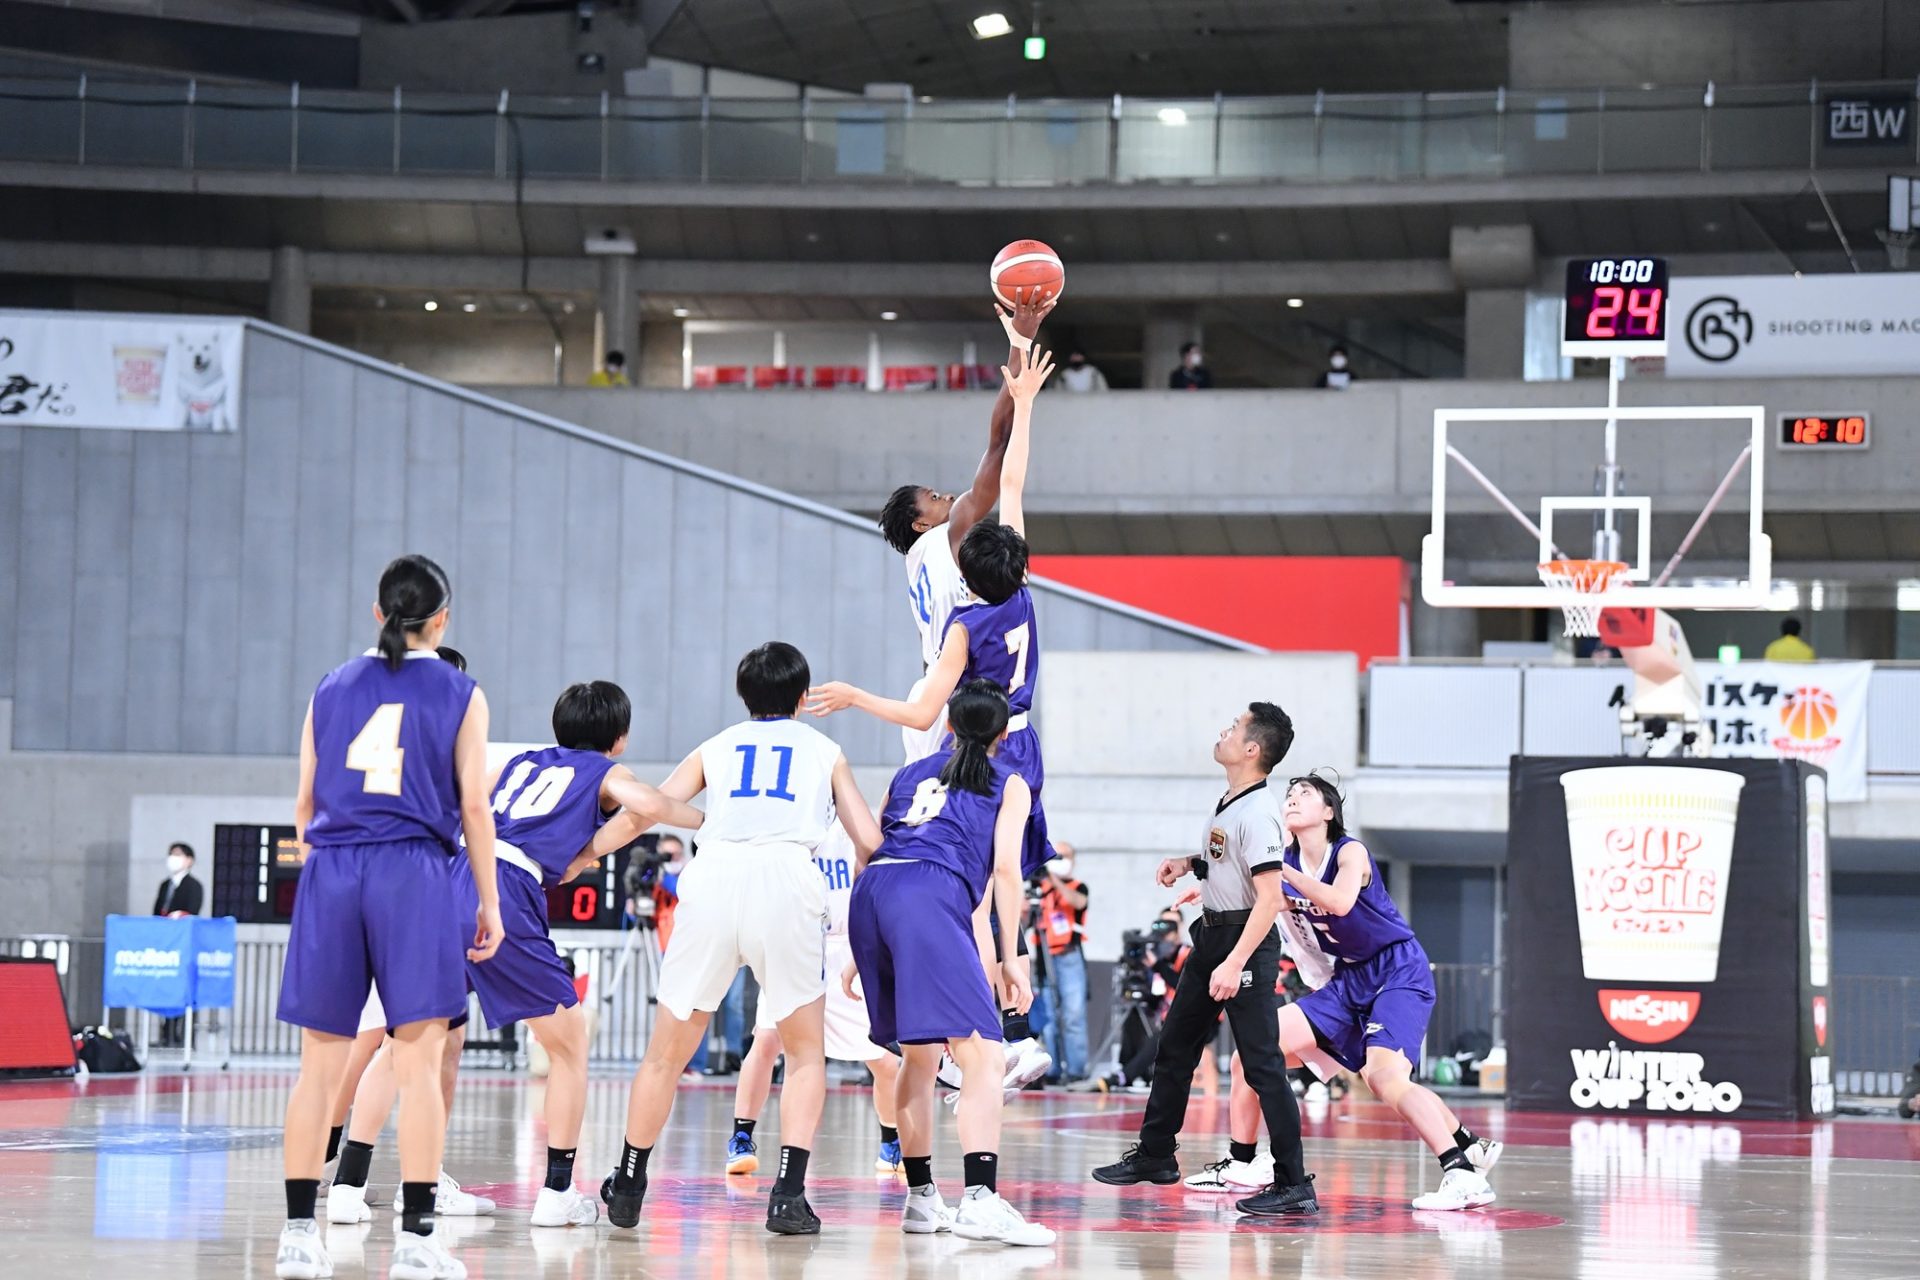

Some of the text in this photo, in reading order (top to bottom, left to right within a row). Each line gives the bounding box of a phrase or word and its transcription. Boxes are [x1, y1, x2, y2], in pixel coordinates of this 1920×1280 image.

[1589, 259, 1654, 283] 10:00
[1586, 287, 1662, 337] 24
[1768, 319, 1872, 335] SHOOTING
[1004, 620, 1030, 695] 7
[345, 703, 404, 797] 4
[491, 760, 575, 820] 10
[730, 745, 796, 802] 11
[900, 777, 950, 827] 6
[572, 886, 597, 921] 0
[115, 948, 180, 967] molten
[1610, 995, 1689, 1026] NISSIN
[1646, 1080, 1743, 1113] 2020
